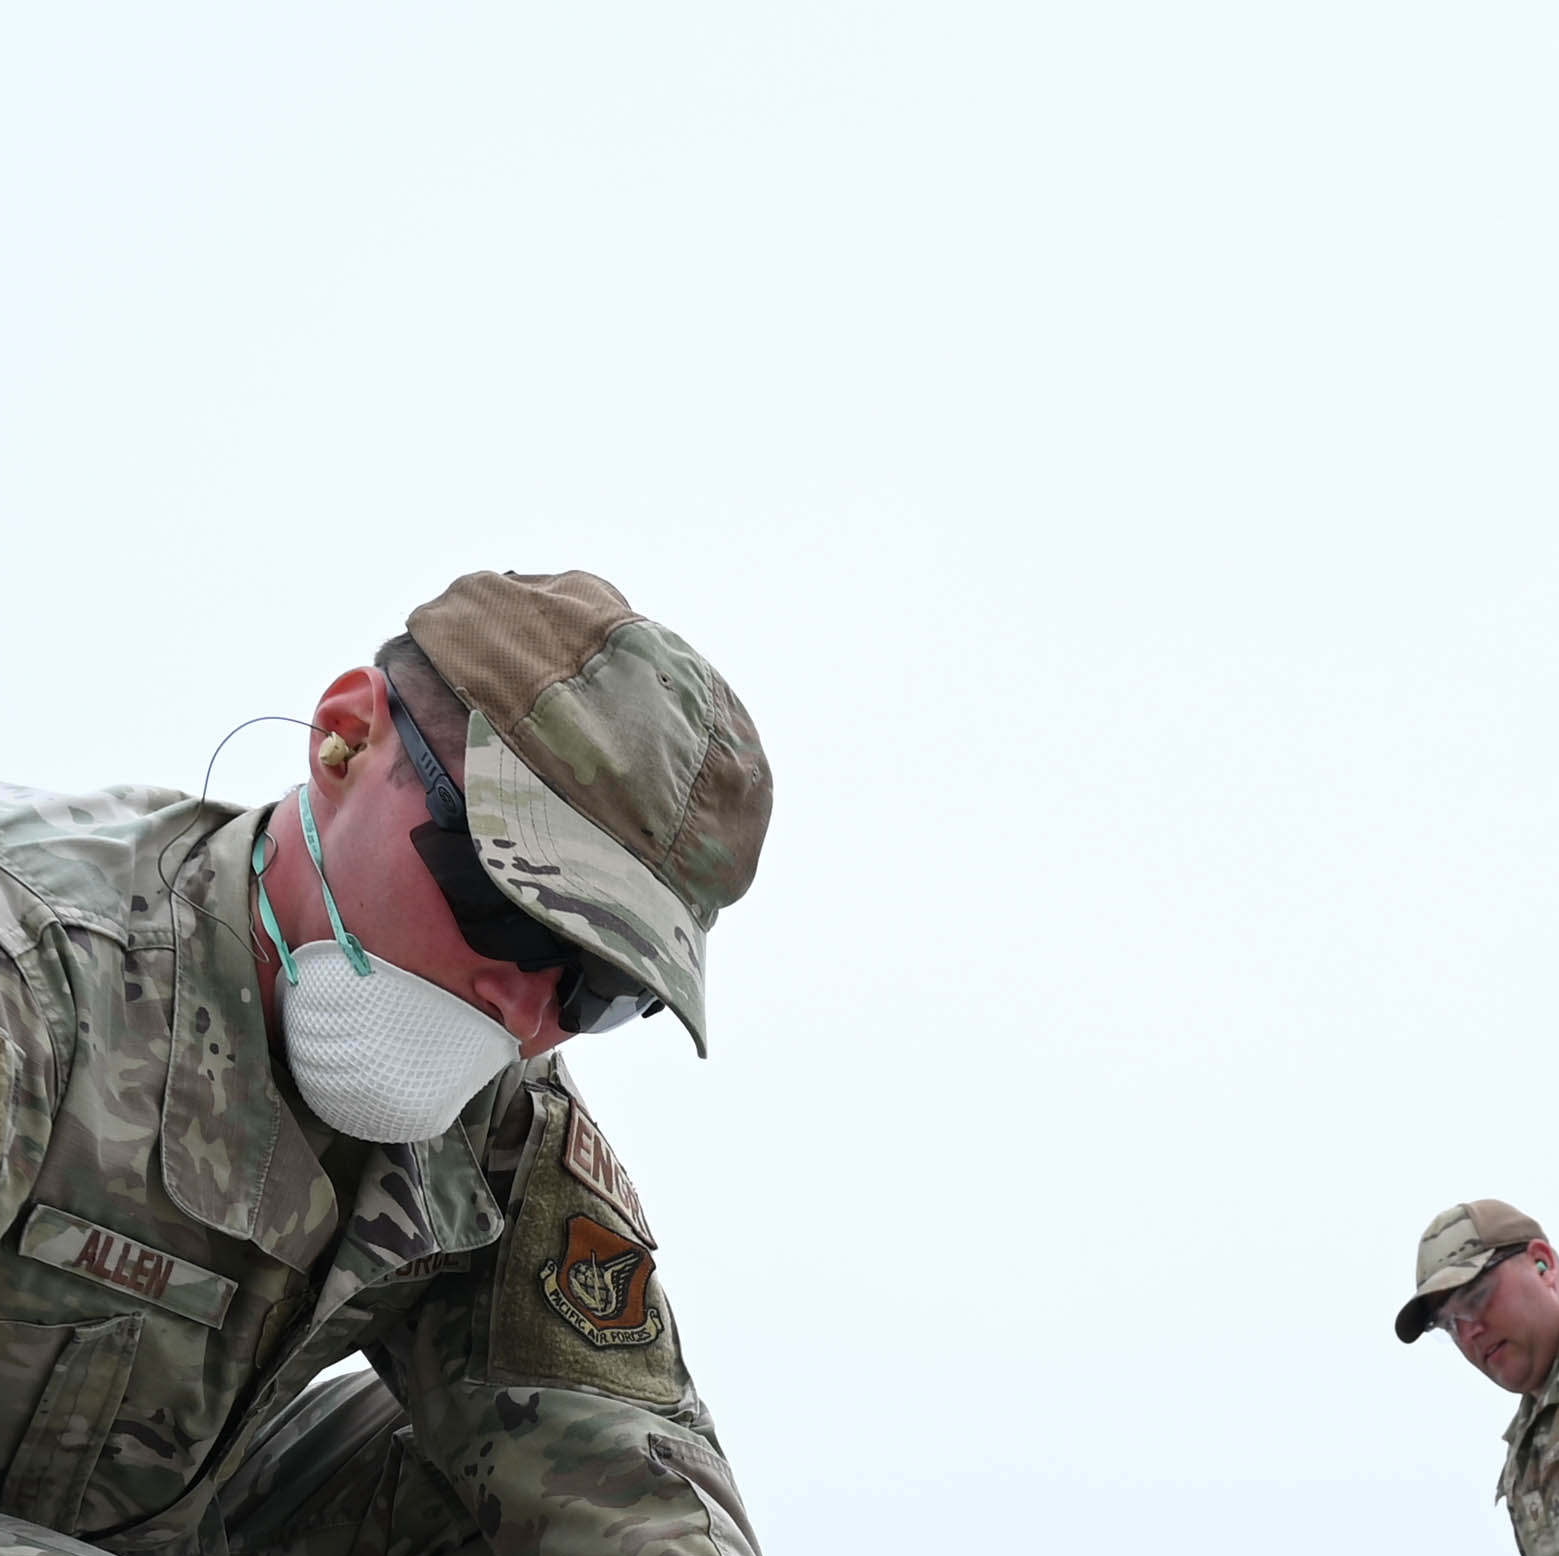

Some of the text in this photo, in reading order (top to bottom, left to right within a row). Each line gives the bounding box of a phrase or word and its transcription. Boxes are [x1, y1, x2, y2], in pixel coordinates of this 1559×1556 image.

[72, 1230, 174, 1299] ALLEN
[549, 1288, 586, 1330] PACIFIC
[587, 1329, 607, 1343] AIR
